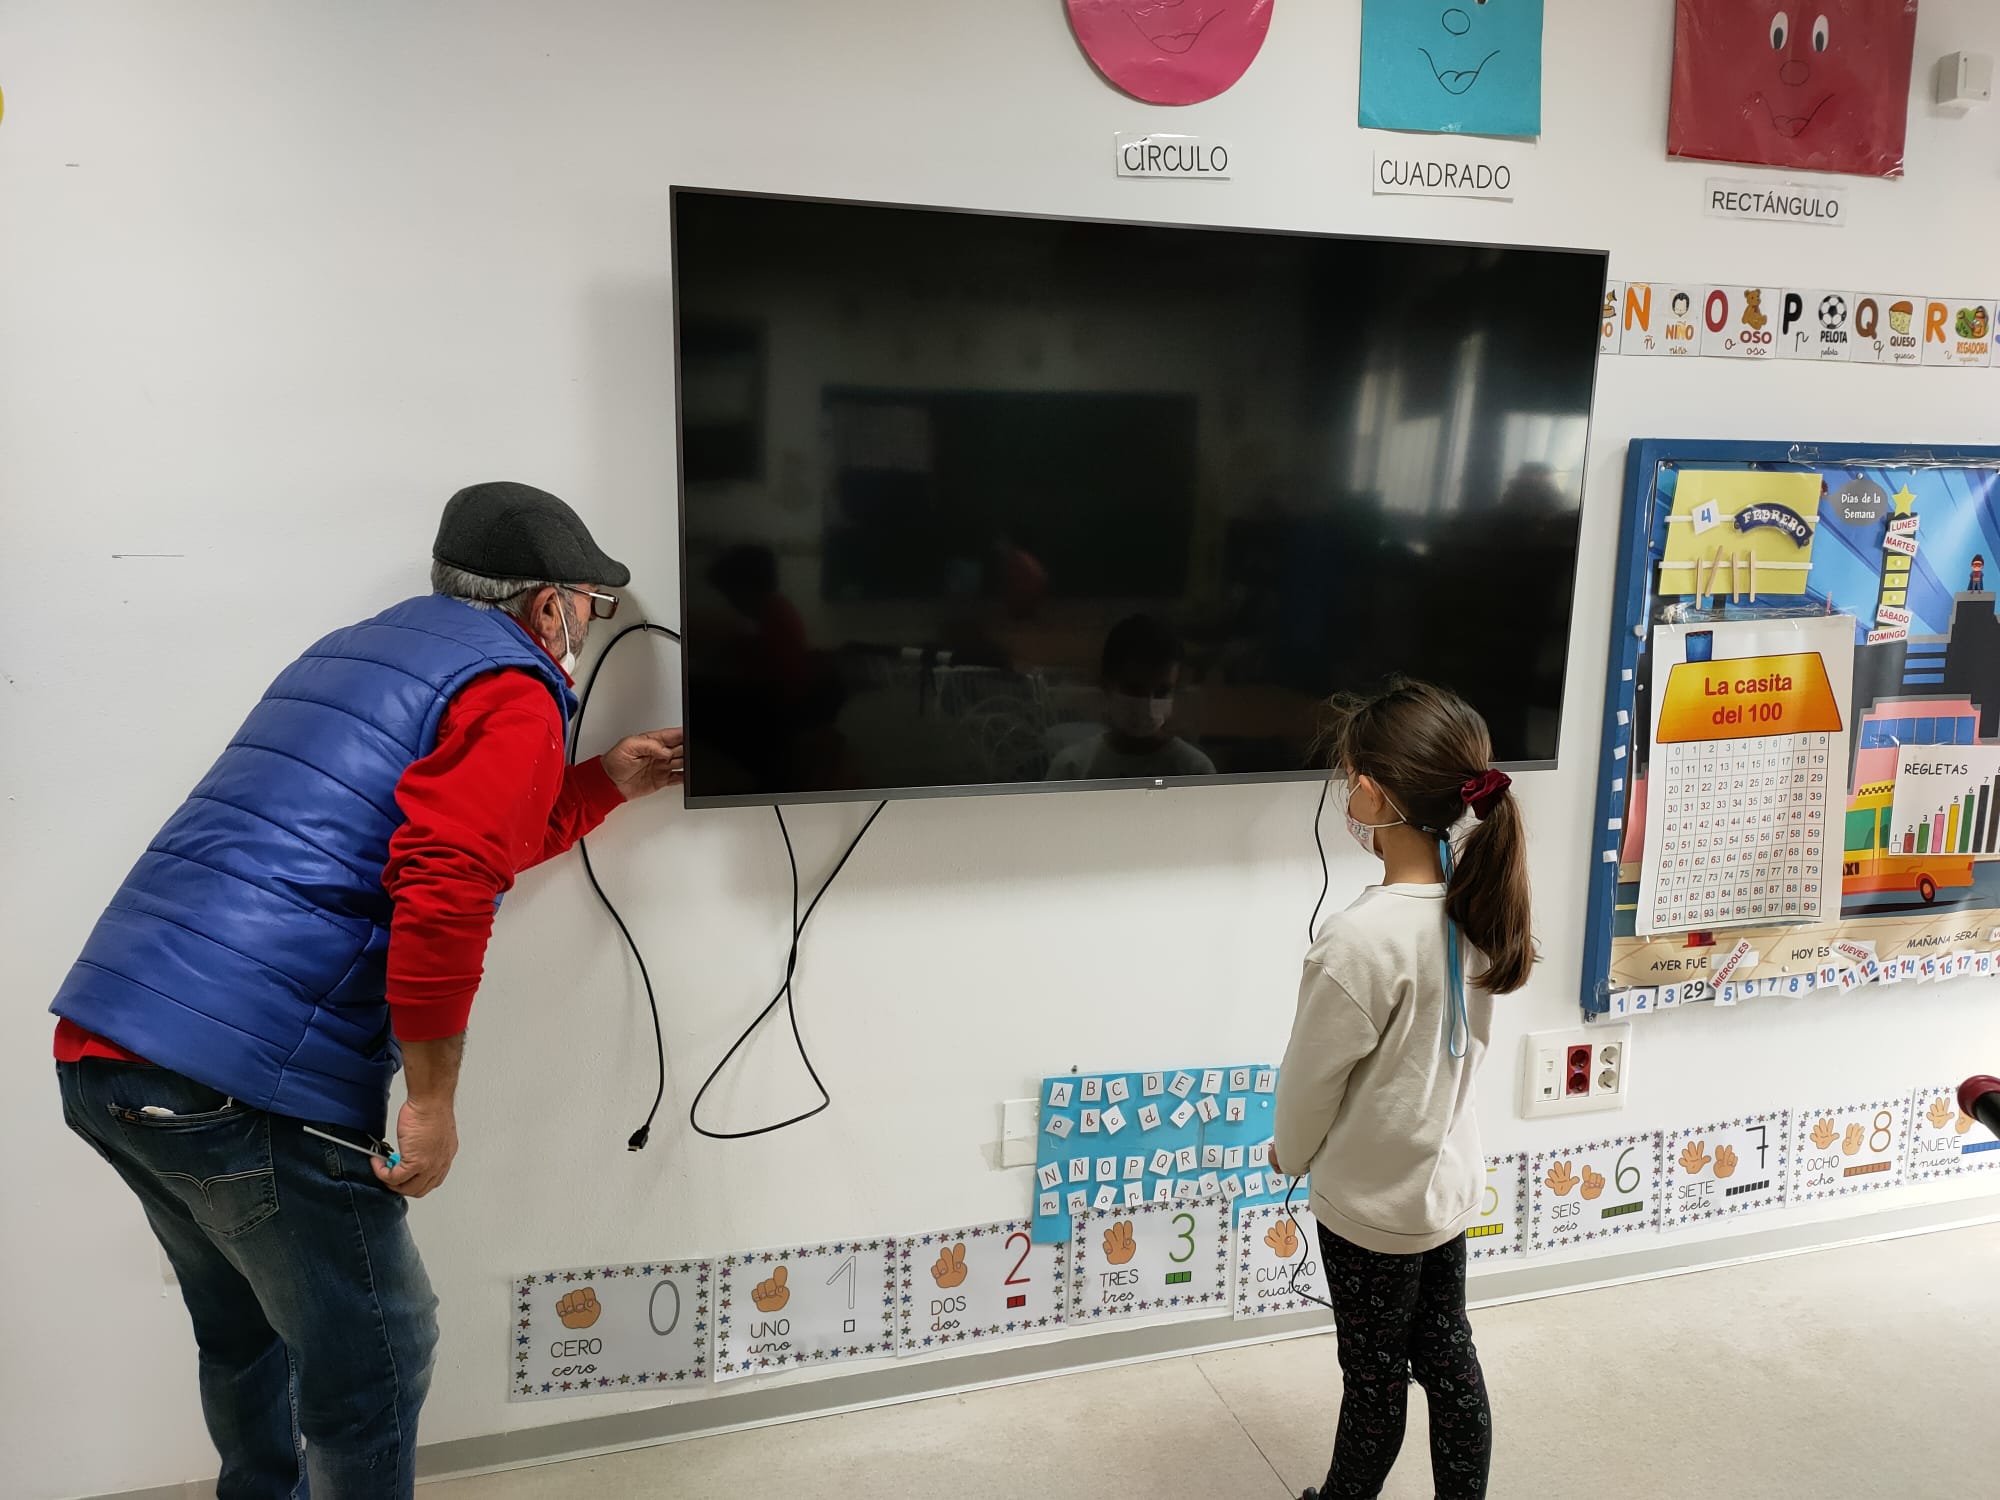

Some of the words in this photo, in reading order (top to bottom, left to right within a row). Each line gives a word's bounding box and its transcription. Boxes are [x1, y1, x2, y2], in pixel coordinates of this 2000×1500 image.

[1124, 137, 1228, 172] CÍRCULO
[1380, 159, 1511, 190] CUADRADO
[1712, 191, 1838, 218] RECTÁNGULO
[1705, 290, 1728, 332] O
[1783, 293, 1802, 335] P
[1856, 298, 1879, 340] Q
[1666, 321, 1694, 340] NIÑO
[1925, 303, 1948, 343] R
[1644, 335, 1655, 350] ñ
[1740, 330, 1772, 344] OSO
[1795, 332, 1809, 352] p
[1820, 331, 1847, 343] PELOTA
[1890, 336, 1916, 347] QUESO
[1747, 347, 1767, 355] oso
[1874, 340, 1884, 360] q
[1956, 341, 1988, 355] REGADORA
[1862, 492, 1871, 503] de
[1874, 492, 1880, 503] la
[1701, 508, 1712, 522] 4
[1844, 508, 1875, 518] Semana
[1742, 509, 1806, 537] FEBRERO
[1892, 520, 1917, 532] LUNES
[1885, 536, 1916, 553] MARTES
[1879, 609, 1909, 623] SÁBADO
[1868, 629, 1906, 642] DOMINGO
[1705, 677, 1728, 696] La
[1735, 674, 1792, 694] casita
[1712, 706, 1742, 725] del
[1749, 702, 1782, 722] 100
[1704, 764, 1712, 772] 12
[1720, 763, 1729, 771] 13
[1752, 760, 1761, 768] 15
[1782, 757, 1790, 765] 17
[1796, 756, 1805, 764] 18
[1813, 755, 1823, 763] 19
[1904, 764, 1968, 775] REGLETAS
[1656, 914, 1666, 922] 90
[1672, 912, 1681, 920] 91
[1688, 911, 1698, 919] 92
[1704, 909, 1713, 917] 93
[1720, 908, 1729, 916] 94
[1768, 903, 1778, 912] 97
[1785, 902, 1796, 910] 98
[1804, 903, 1816, 911] 99
[1907, 935, 1951, 949] MAÑANA
[1954, 928, 1980, 942] SERÁ
[1791, 948, 1813, 960] HOY
[1818, 947, 1830, 957] ES
[1838, 943, 1868, 960] JUEVES
[1651, 959, 1681, 971] AYER
[1686, 957, 1707, 969] FUE
[1713, 942, 1748, 988] MIÉRCOLES
[1618, 998, 1624, 1012] 1
[1636, 995, 1646, 1009] 2
[1665, 989, 1674, 1003] 3
[1684, 981, 1704, 999] 29
[1724, 987, 1732, 1001] 5
[1745, 981, 1753, 993] 6
[1768, 978, 1777, 991] 7
[1789, 978, 1798, 992] 8
[1806, 973, 1815, 987] 9
[1820, 968, 1835, 983] 10
[1842, 972, 1856, 988] 11
[1860, 960, 1878, 978] 12
[1883, 965, 1897, 979] 13
[1901, 960, 1914, 973] 14
[1921, 960, 1934, 976] 15
[1940, 961, 1952, 975] 16
[1957, 955, 1971, 970] 17
[1975, 957, 1988, 972] 18
[1054, 1087, 1065, 1101] A
[1086, 1081, 1095, 1095] B
[1112, 1082, 1122, 1096] C
[1148, 1076, 1157, 1090] D
[1175, 1076, 1189, 1091] E
[1206, 1074, 1216, 1088] F
[1235, 1072, 1244, 1085] G
[1260, 1074, 1269, 1087] H
[1086, 1113, 1094, 1126] b
[1145, 1108, 1156, 1123] d
[1178, 1111, 1185, 1119] e
[1204, 1102, 1211, 1120] f
[1869, 1111, 1891, 1152] 8
[1746, 1125, 1769, 1169] 7
[1920, 1136, 1962, 1152] NUEVE
[1044, 1168, 1057, 1184] N
[1074, 1159, 1083, 1176] Ñ
[1101, 1161, 1110, 1175] O
[1129, 1160, 1138, 1173] P
[1157, 1154, 1167, 1168] Q
[1181, 1152, 1190, 1166] R
[1208, 1149, 1216, 1162] S
[1230, 1150, 1238, 1163] T
[1254, 1149, 1263, 1161] U
[1616, 1146, 1640, 1193] 6
[1807, 1155, 1839, 1171] OCHO
[1919, 1156, 1960, 1167] nueve
[1806, 1172, 1834, 1187] ocho
[1043, 1201, 1056, 1210] n
[1072, 1197, 1084, 1207] ñ
[1129, 1193, 1139, 1206] p
[1160, 1188, 1167, 1203] q
[1227, 1180, 1236, 1192] t
[1481, 1168, 1498, 1216] 5
[1678, 1180, 1715, 1199] SIETE
[1551, 1202, 1581, 1219] SEIS
[1552, 1222, 1578, 1233] seis
[1169, 1213, 1195, 1263] 3
[1004, 1232, 1031, 1286] 2
[1100, 1269, 1139, 1288] TRES
[1257, 1261, 1316, 1282] CUATRO
[826, 1255, 856, 1309] 1
[931, 1296, 967, 1315] DOS
[1103, 1289, 1134, 1304] tres
[649, 1279, 680, 1335] 0
[750, 1319, 790, 1338] UNO
[931, 1317, 960, 1331] dos
[551, 1338, 602, 1358] CERO
[746, 1340, 791, 1354] uno
[551, 1361, 598, 1377] cero
